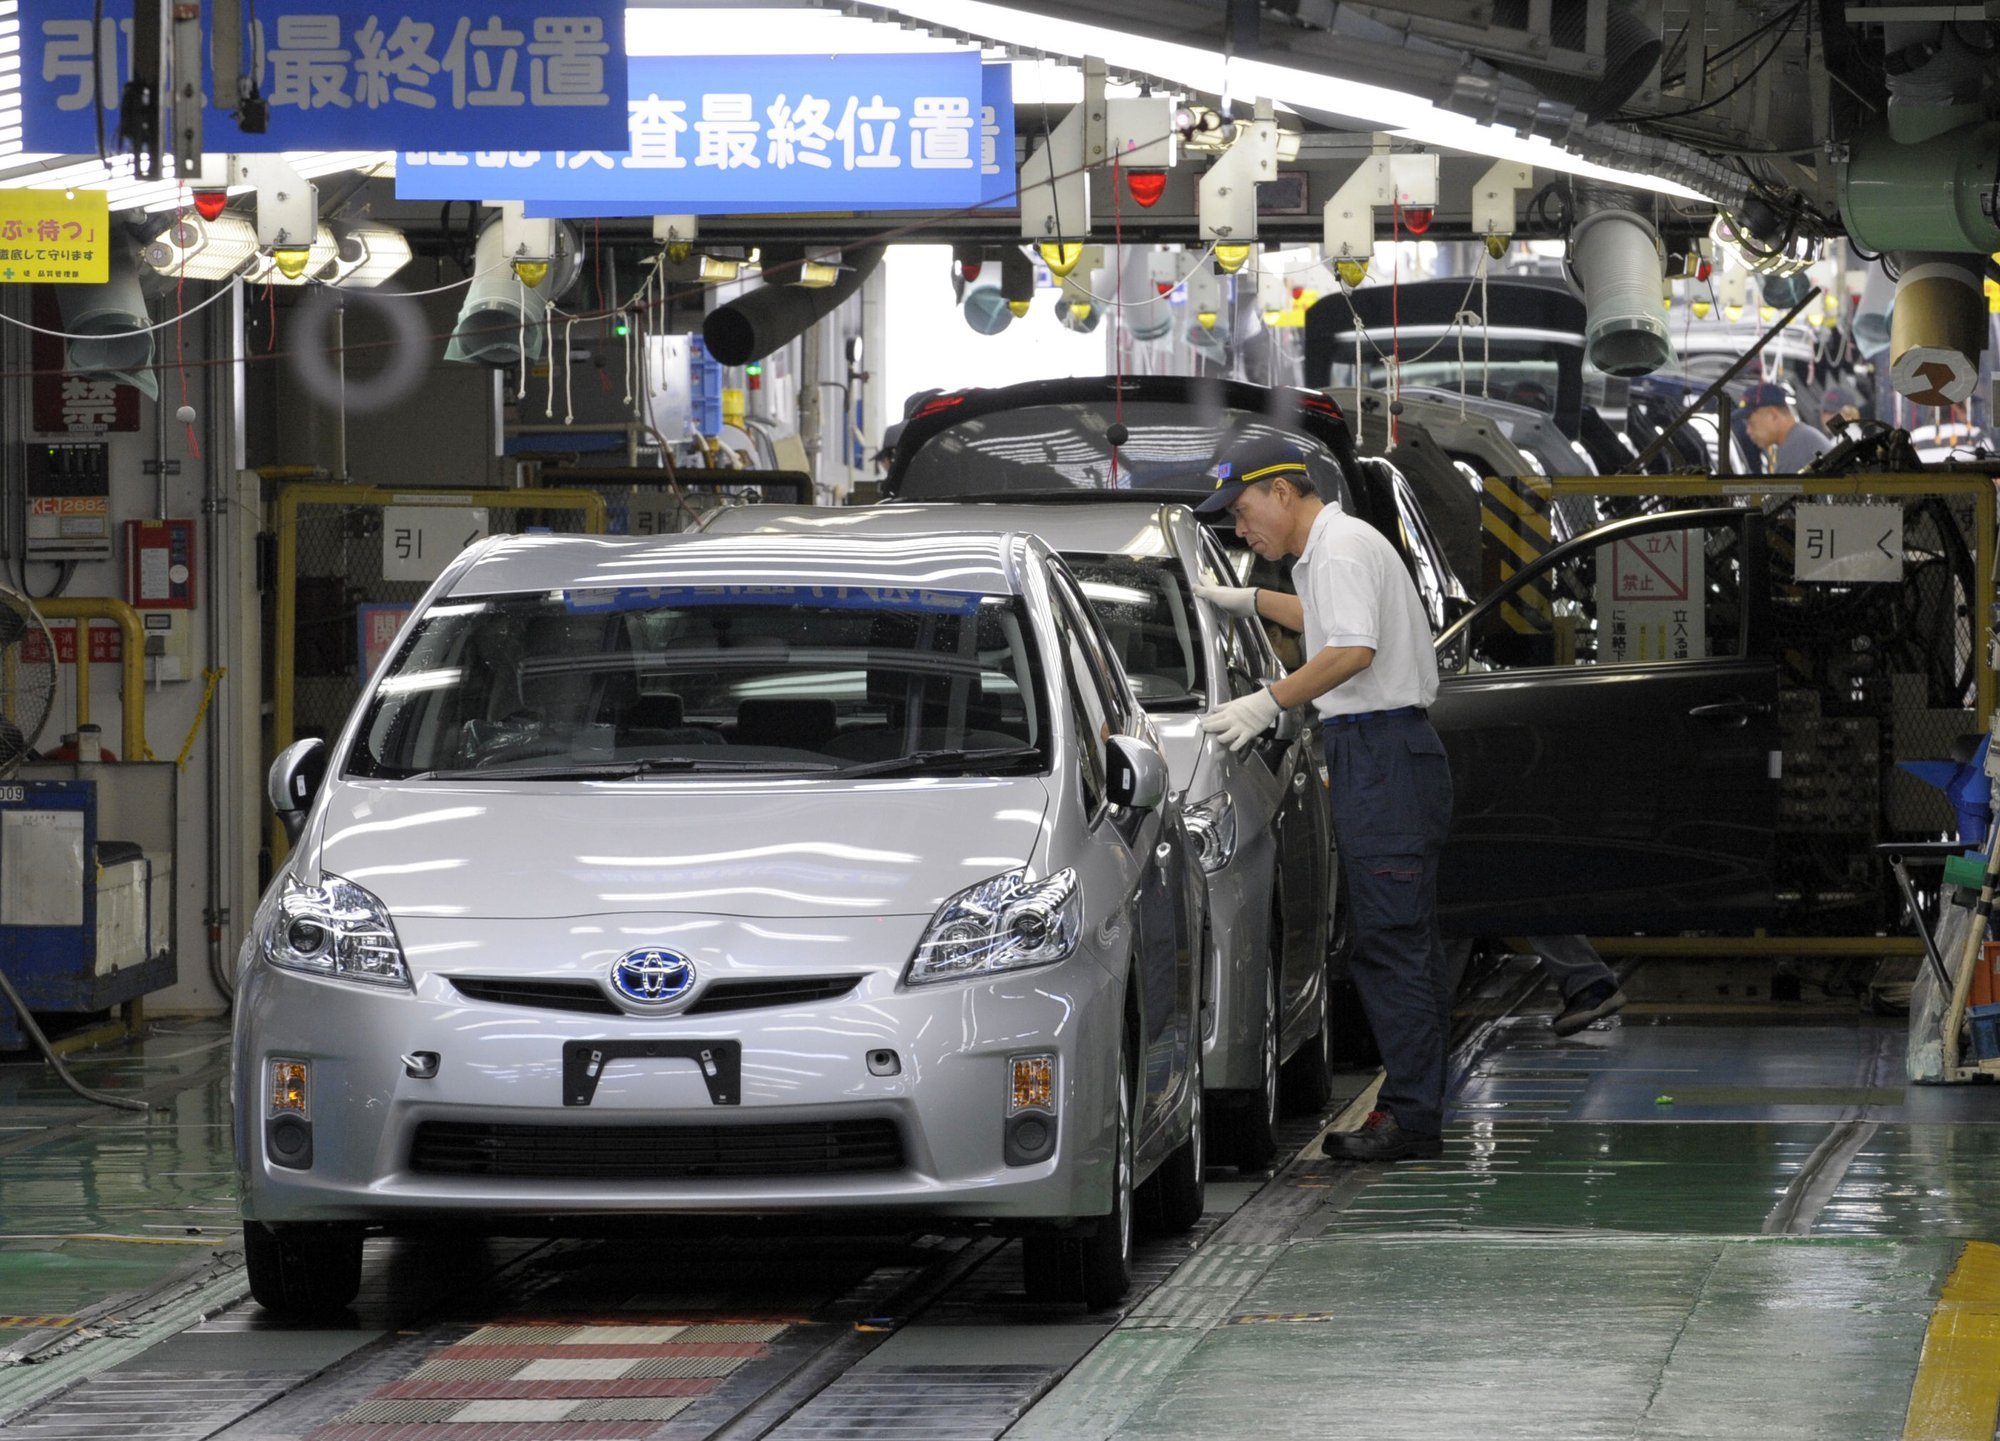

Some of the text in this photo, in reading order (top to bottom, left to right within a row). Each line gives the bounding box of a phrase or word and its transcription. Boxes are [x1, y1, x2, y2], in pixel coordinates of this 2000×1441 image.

[42, 15, 609, 110] 引最終位置
[405, 93, 974, 170] 査最終位置
[1646, 535, 1678, 554] 立入
[1806, 529, 1894, 560] 引く
[1624, 573, 1655, 592] 禁止
